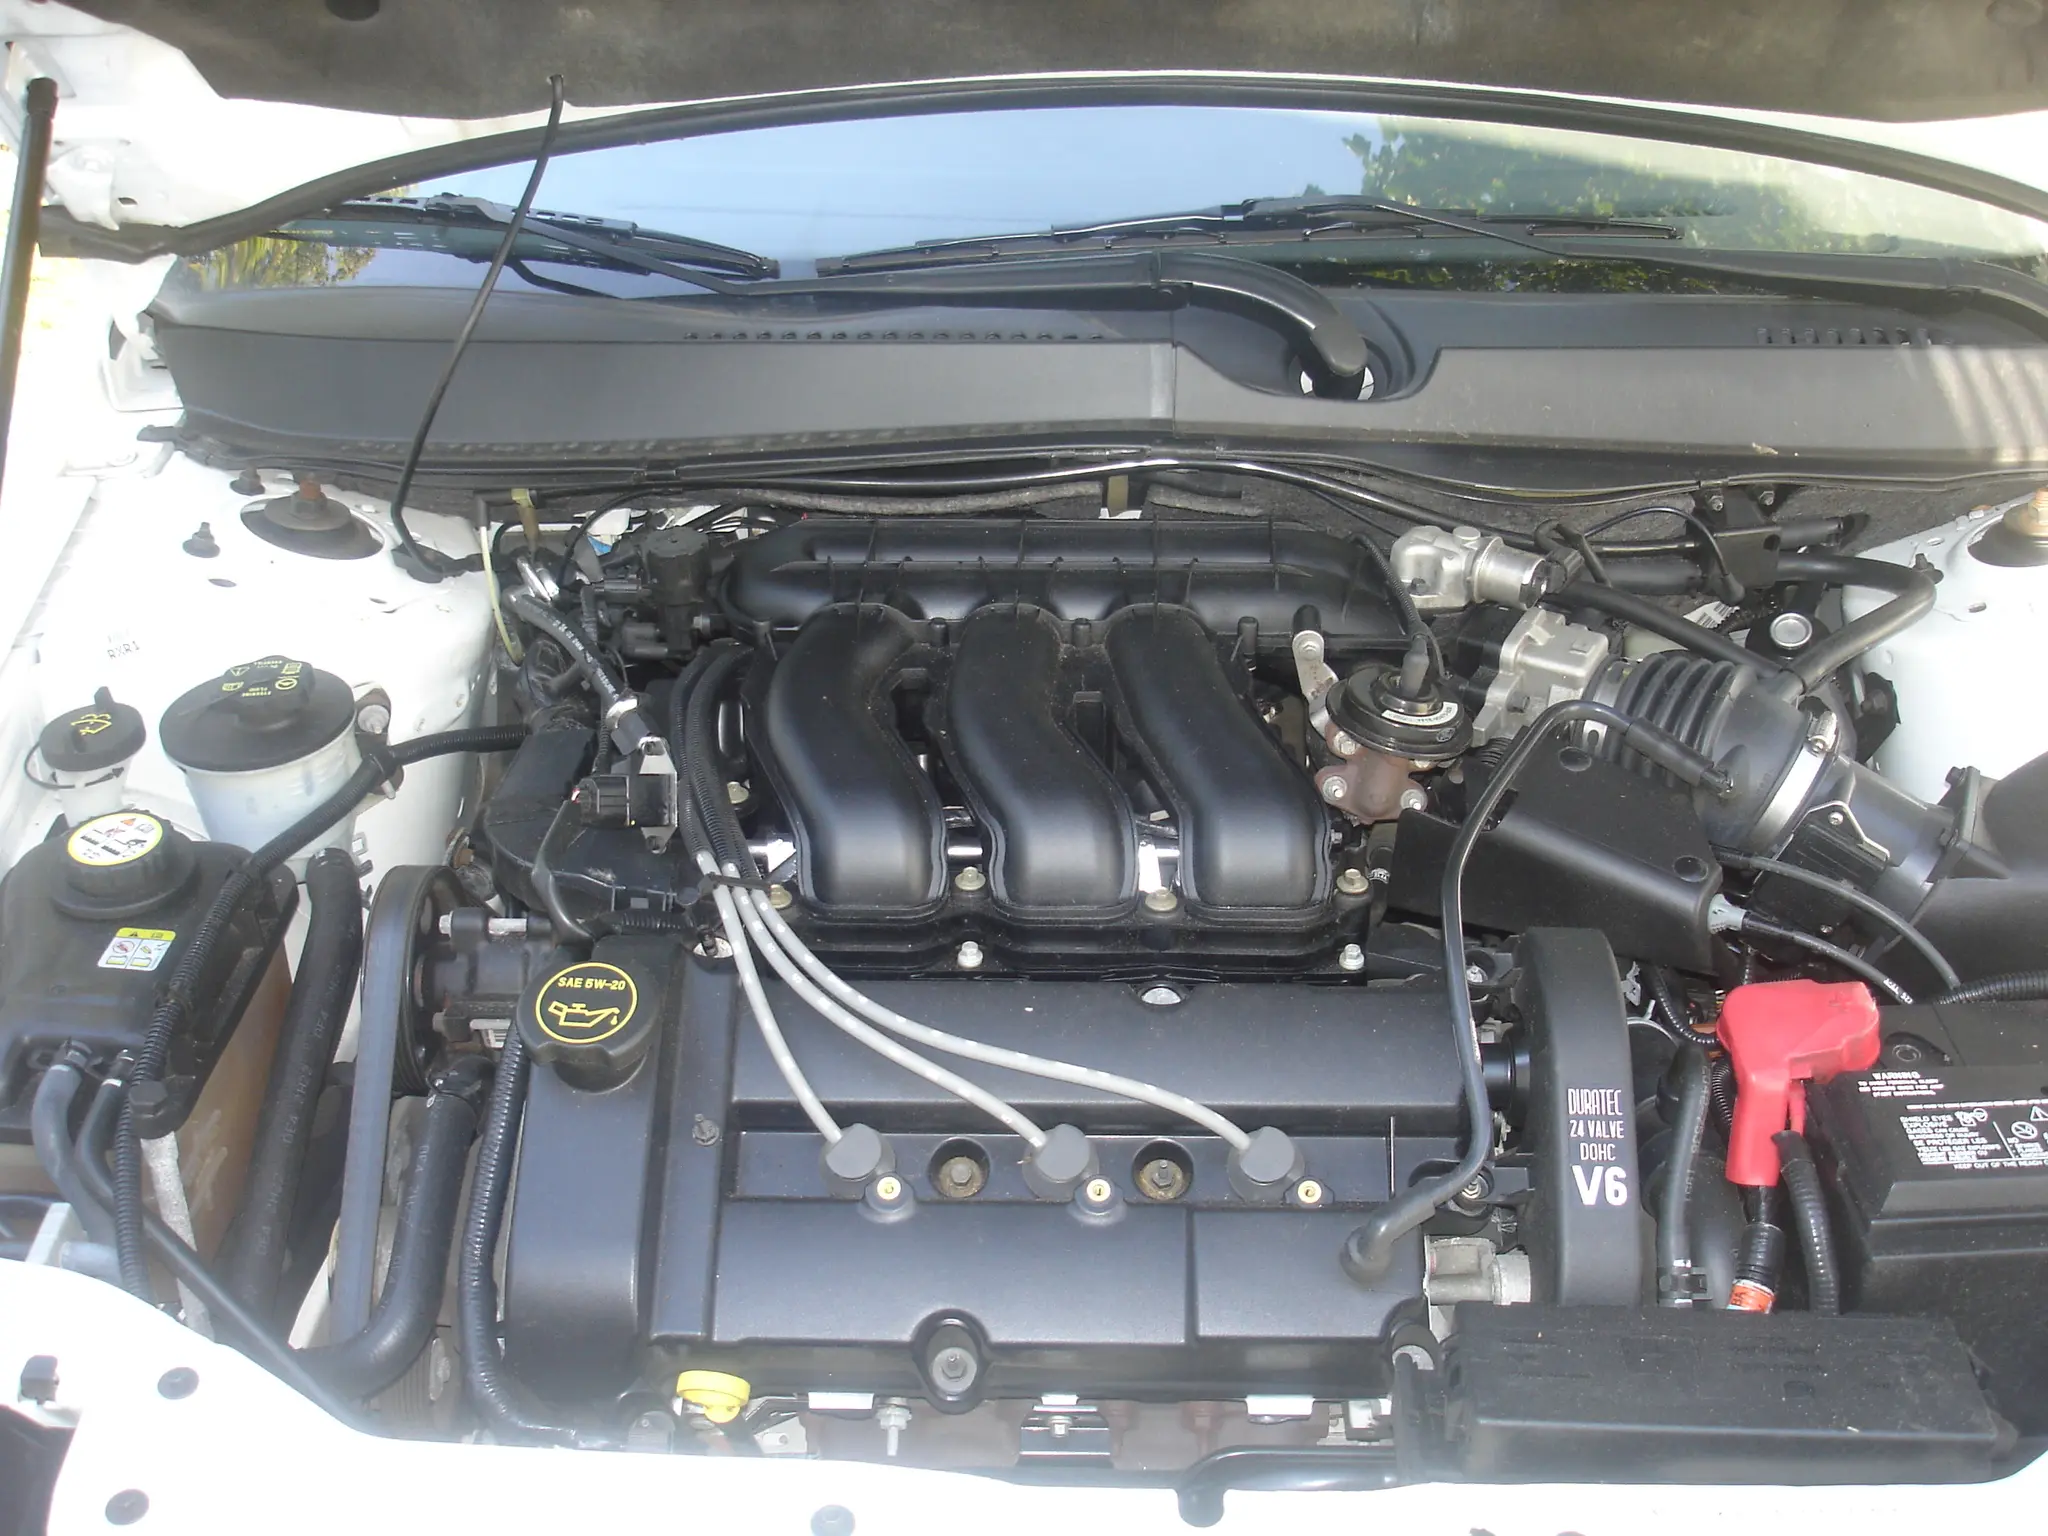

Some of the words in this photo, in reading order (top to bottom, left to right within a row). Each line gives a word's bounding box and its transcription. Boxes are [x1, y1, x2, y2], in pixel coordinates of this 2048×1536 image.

[557, 977, 583, 988] SAE
[584, 978, 626, 991] 5W-20
[1871, 1071, 1921, 1080] WARNING
[1567, 1088, 1623, 1116] DURATEC
[1900, 1115, 1930, 1123] SHIELD
[1569, 1119, 1585, 1138] 24
[1587, 1120, 1625, 1139] VALVE
[1579, 1142, 1617, 1161] DOHC
[1571, 1164, 1628, 1206] V6
